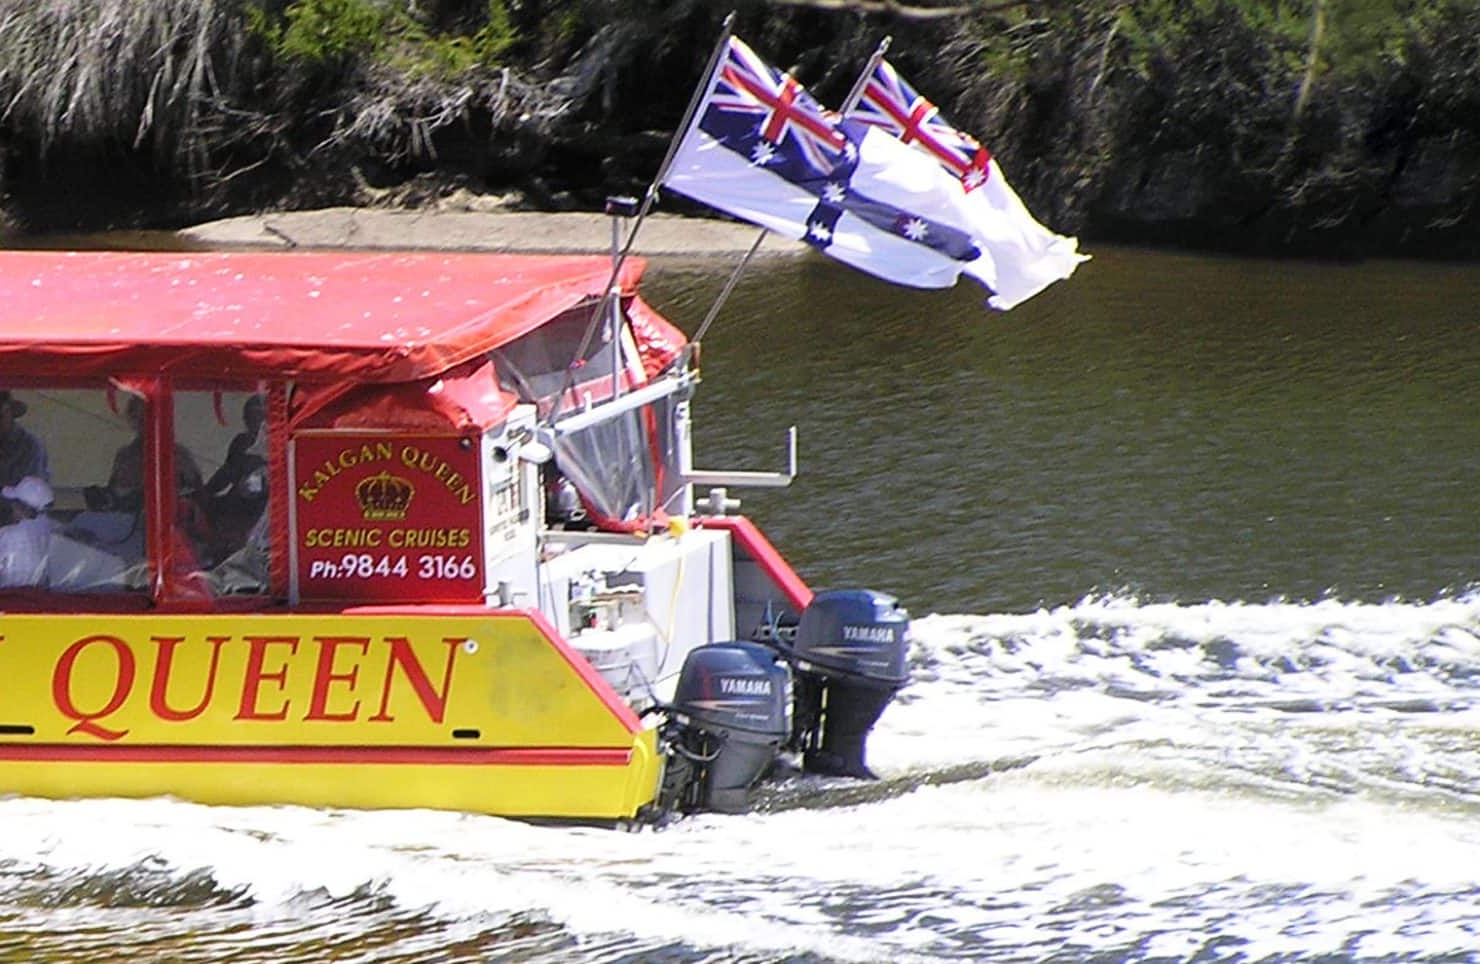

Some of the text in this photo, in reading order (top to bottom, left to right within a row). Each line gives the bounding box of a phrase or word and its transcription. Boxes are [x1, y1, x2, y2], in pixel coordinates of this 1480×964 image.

[298, 442, 476, 504] KALGAN QUEEN
[305, 529, 382, 547] SCENIC
[388, 529, 470, 548] CRUISES
[418, 555, 476, 579] 3166
[842, 625, 894, 643] YAMAHA
[51, 635, 470, 741] QUEEN
[720, 678, 771, 696] YAMAHA
